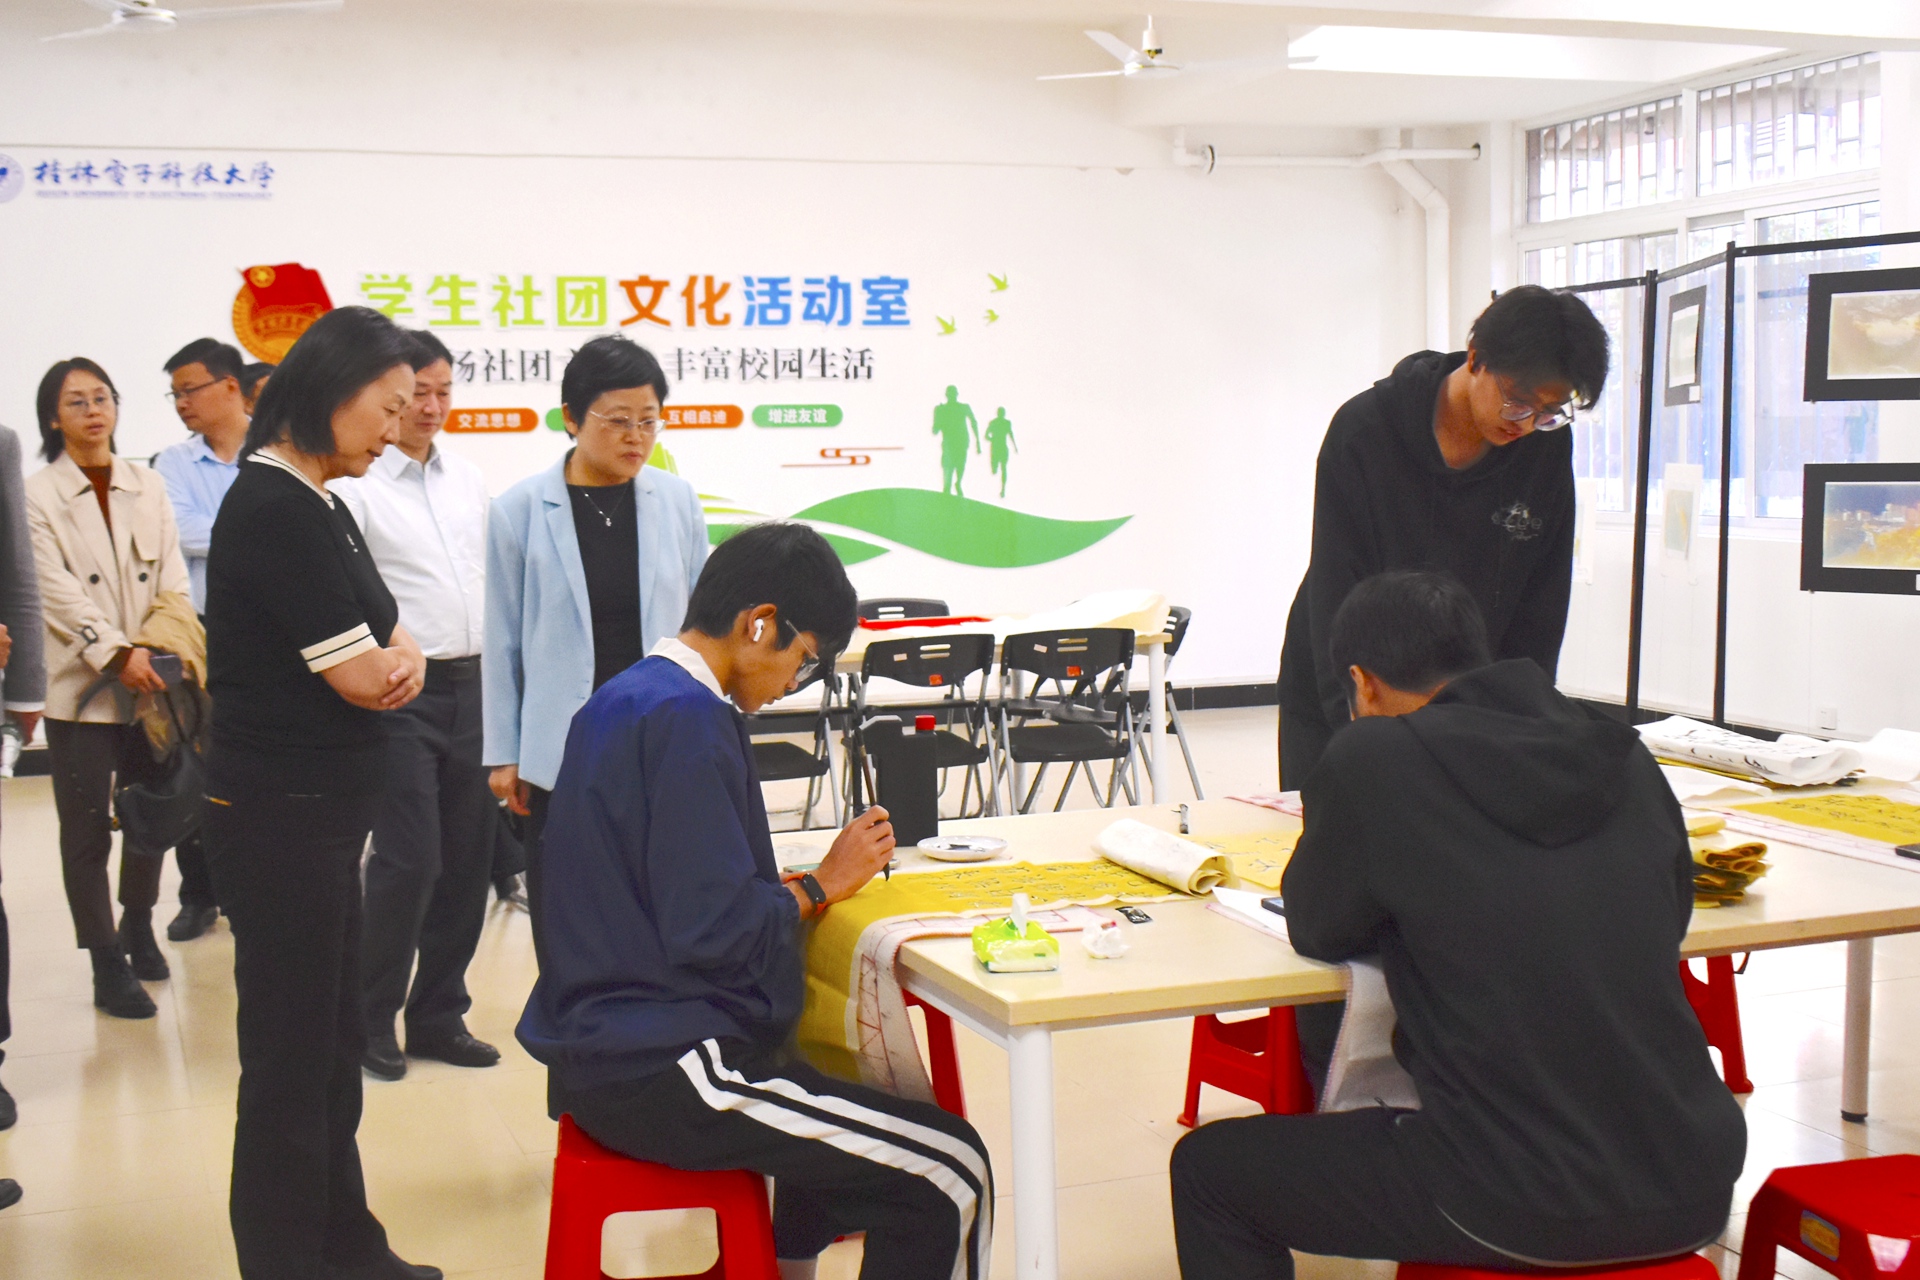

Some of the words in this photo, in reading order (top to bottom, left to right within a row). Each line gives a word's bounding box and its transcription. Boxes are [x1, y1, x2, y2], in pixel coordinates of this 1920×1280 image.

[359, 273, 911, 328] 学生社团文化活动室
[453, 347, 576, 383] 扬社团
[664, 346, 875, 381] 丰富校园生活
[457, 412, 521, 429] 交流思想
[668, 409, 727, 425] 互相启迪
[768, 407, 828, 424] 增进友谊
